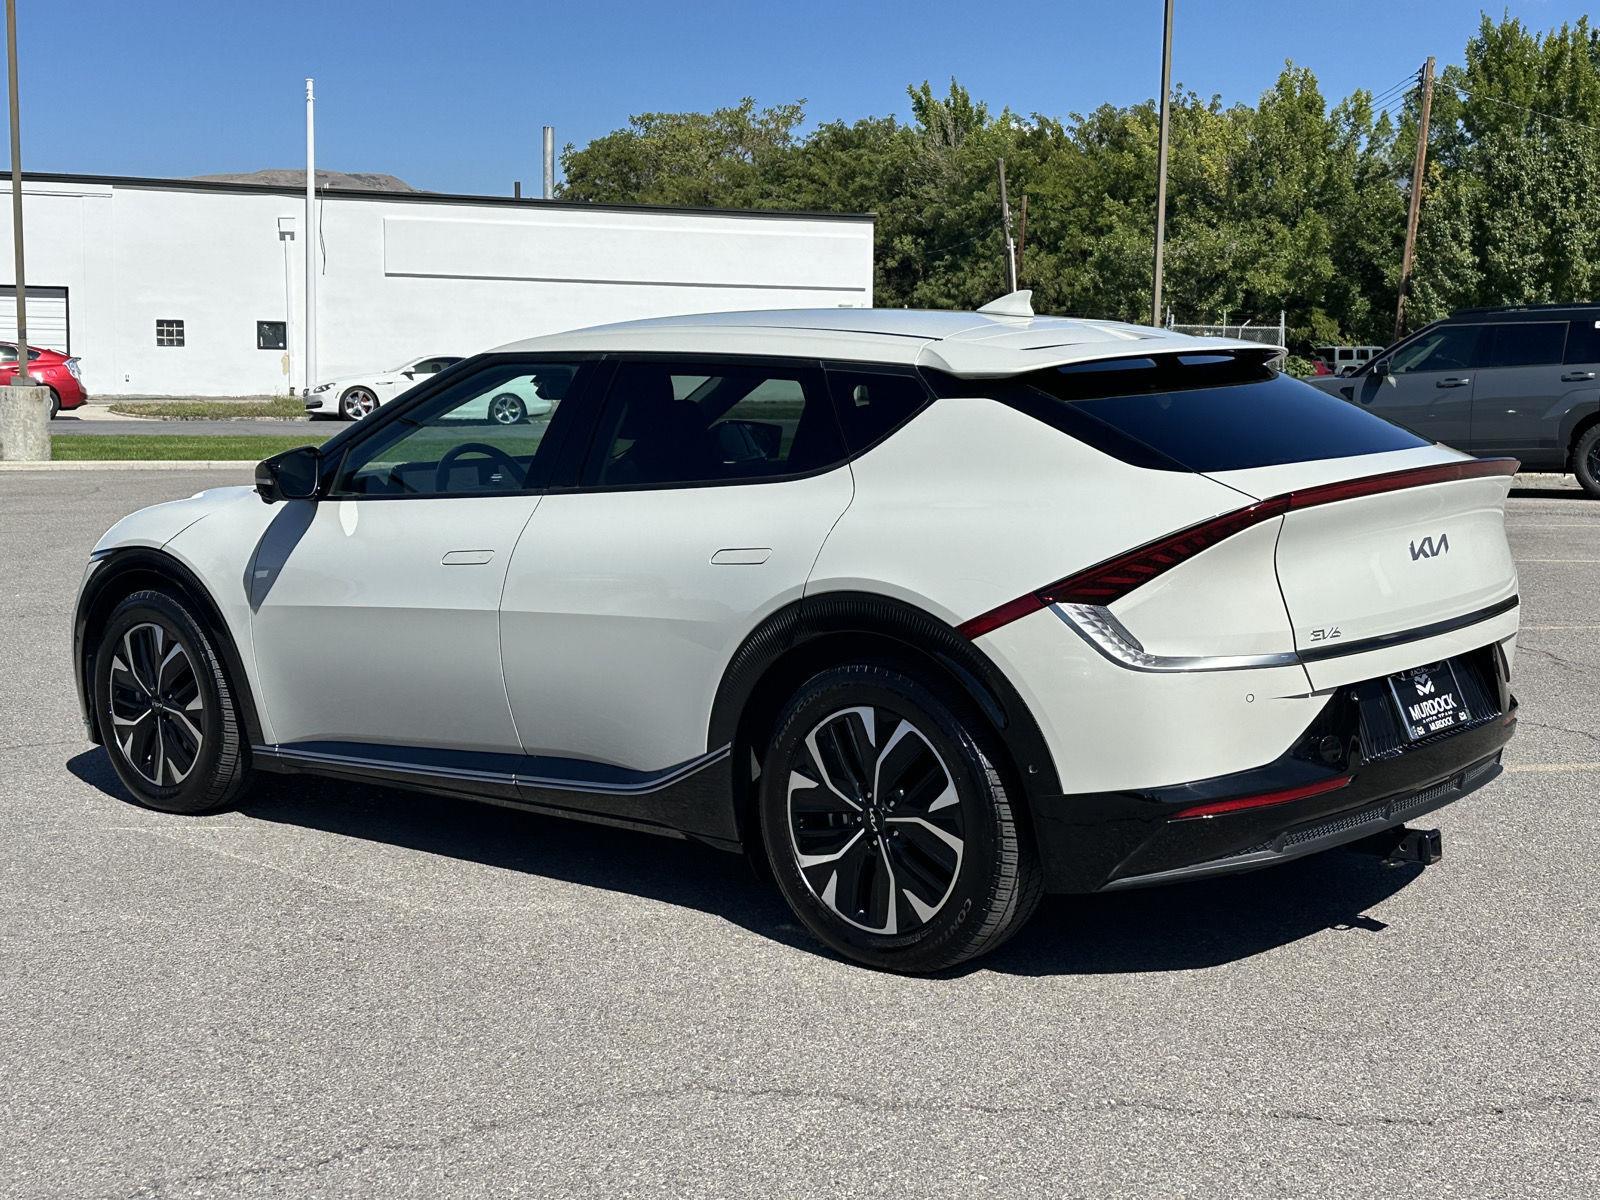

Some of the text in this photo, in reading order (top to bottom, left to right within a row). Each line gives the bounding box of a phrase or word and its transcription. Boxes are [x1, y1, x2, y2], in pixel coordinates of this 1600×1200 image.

[1409, 533, 1450, 561] KIA
[1310, 626, 1342, 642] EV6
[1408, 692, 1458, 721] MURDOCK
[1428, 715, 1455, 732] MURDOCK
